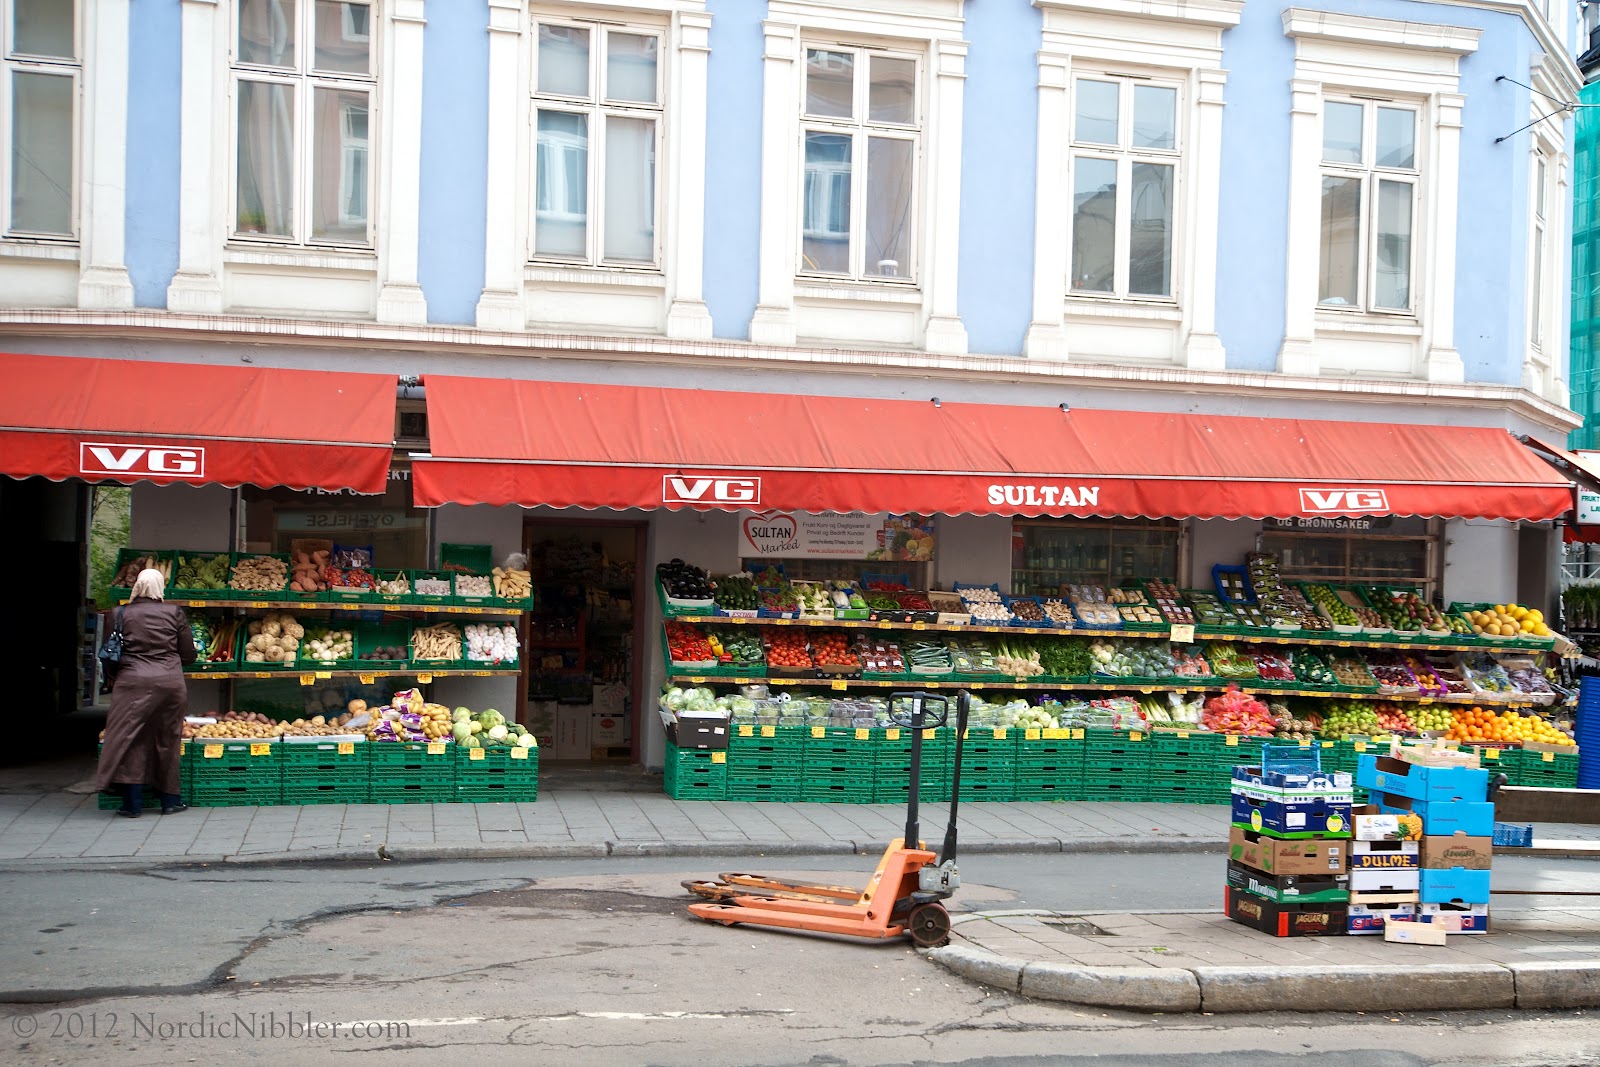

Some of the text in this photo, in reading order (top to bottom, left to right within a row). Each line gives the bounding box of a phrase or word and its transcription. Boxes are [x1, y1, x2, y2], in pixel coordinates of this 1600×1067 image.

[88, 446, 197, 473] VG
[669, 478, 755, 501] VG
[987, 484, 1100, 507] SULTAN
[1304, 491, 1383, 510] VG
[751, 526, 792, 539] SULTAN
[1276, 518, 1370, 530] OG GRØNNSAKER
[760, 540, 801, 555] Marked
[1361, 855, 1412, 867] DULME
